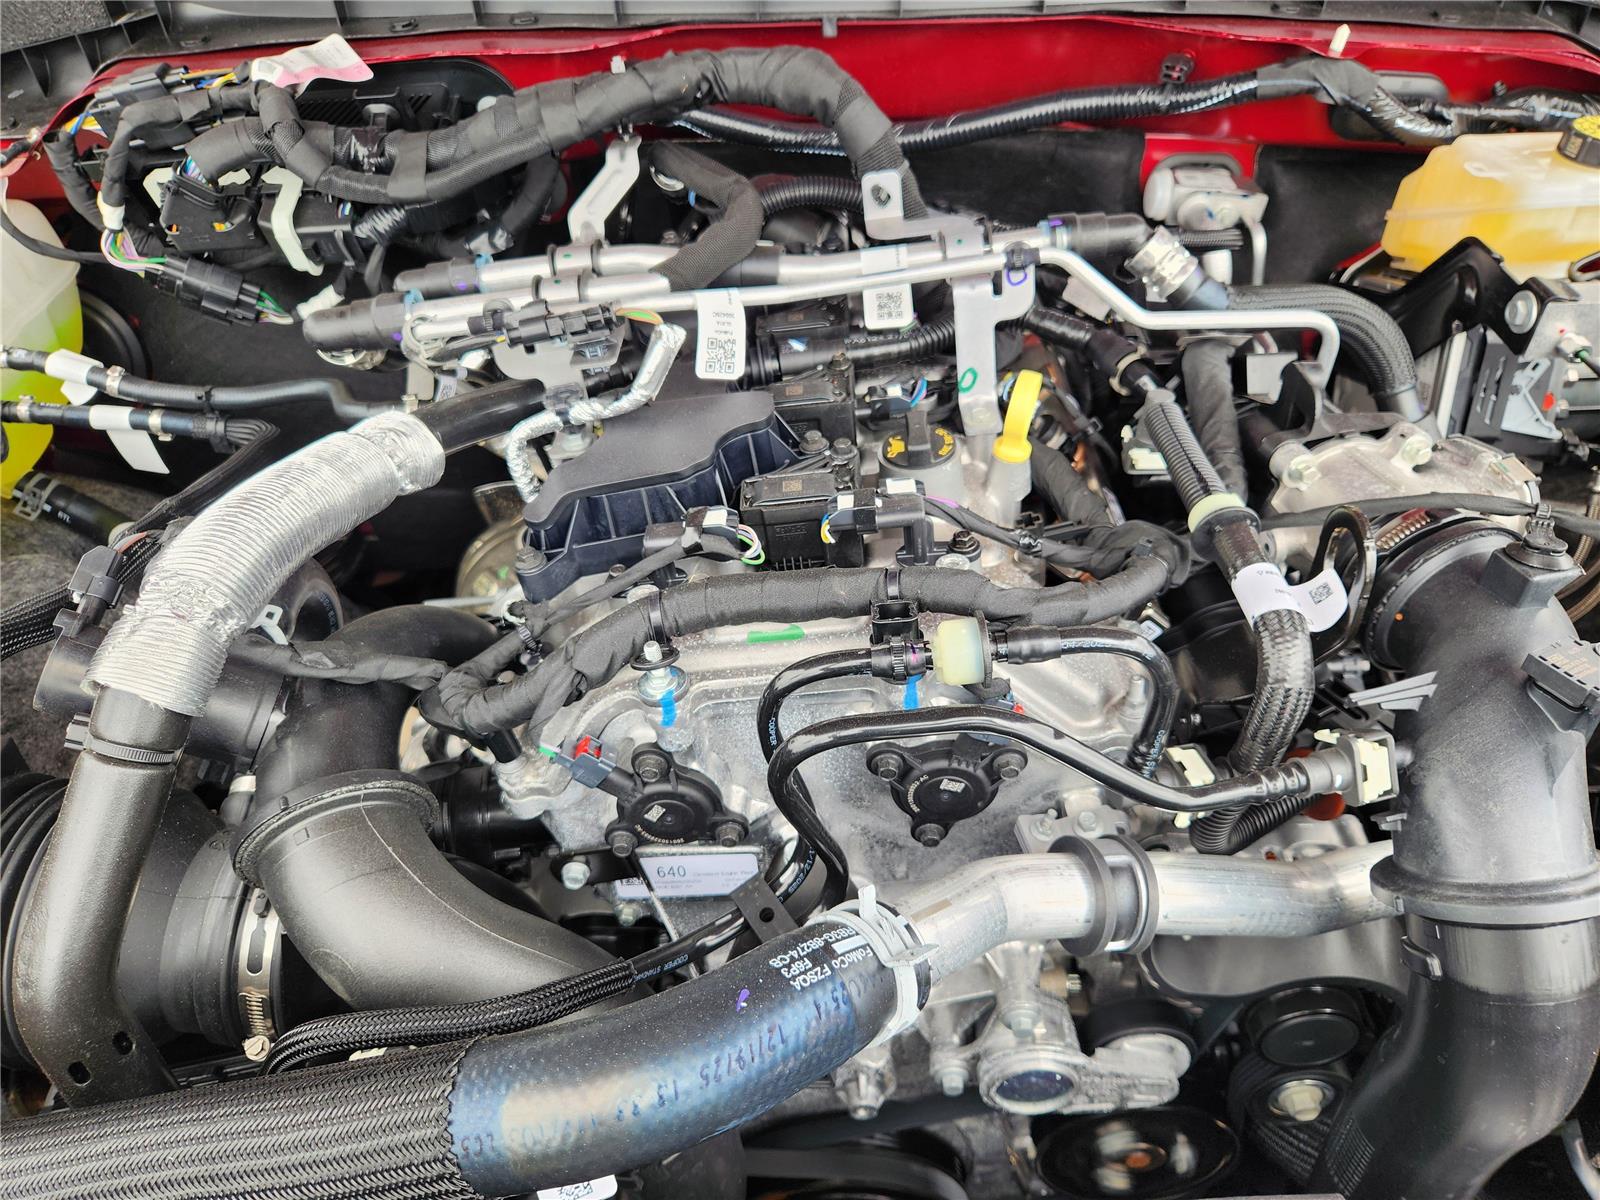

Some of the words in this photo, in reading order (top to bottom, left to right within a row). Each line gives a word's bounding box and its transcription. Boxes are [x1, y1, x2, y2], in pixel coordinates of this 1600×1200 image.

[768, 717, 778, 746] COOPER
[657, 865, 687, 878] 640
[663, 953, 689, 970] COOPER
[781, 957, 812, 978] F6P3
[832, 945, 873, 969] FoMoCo
[790, 963, 832, 991] FZSQA
